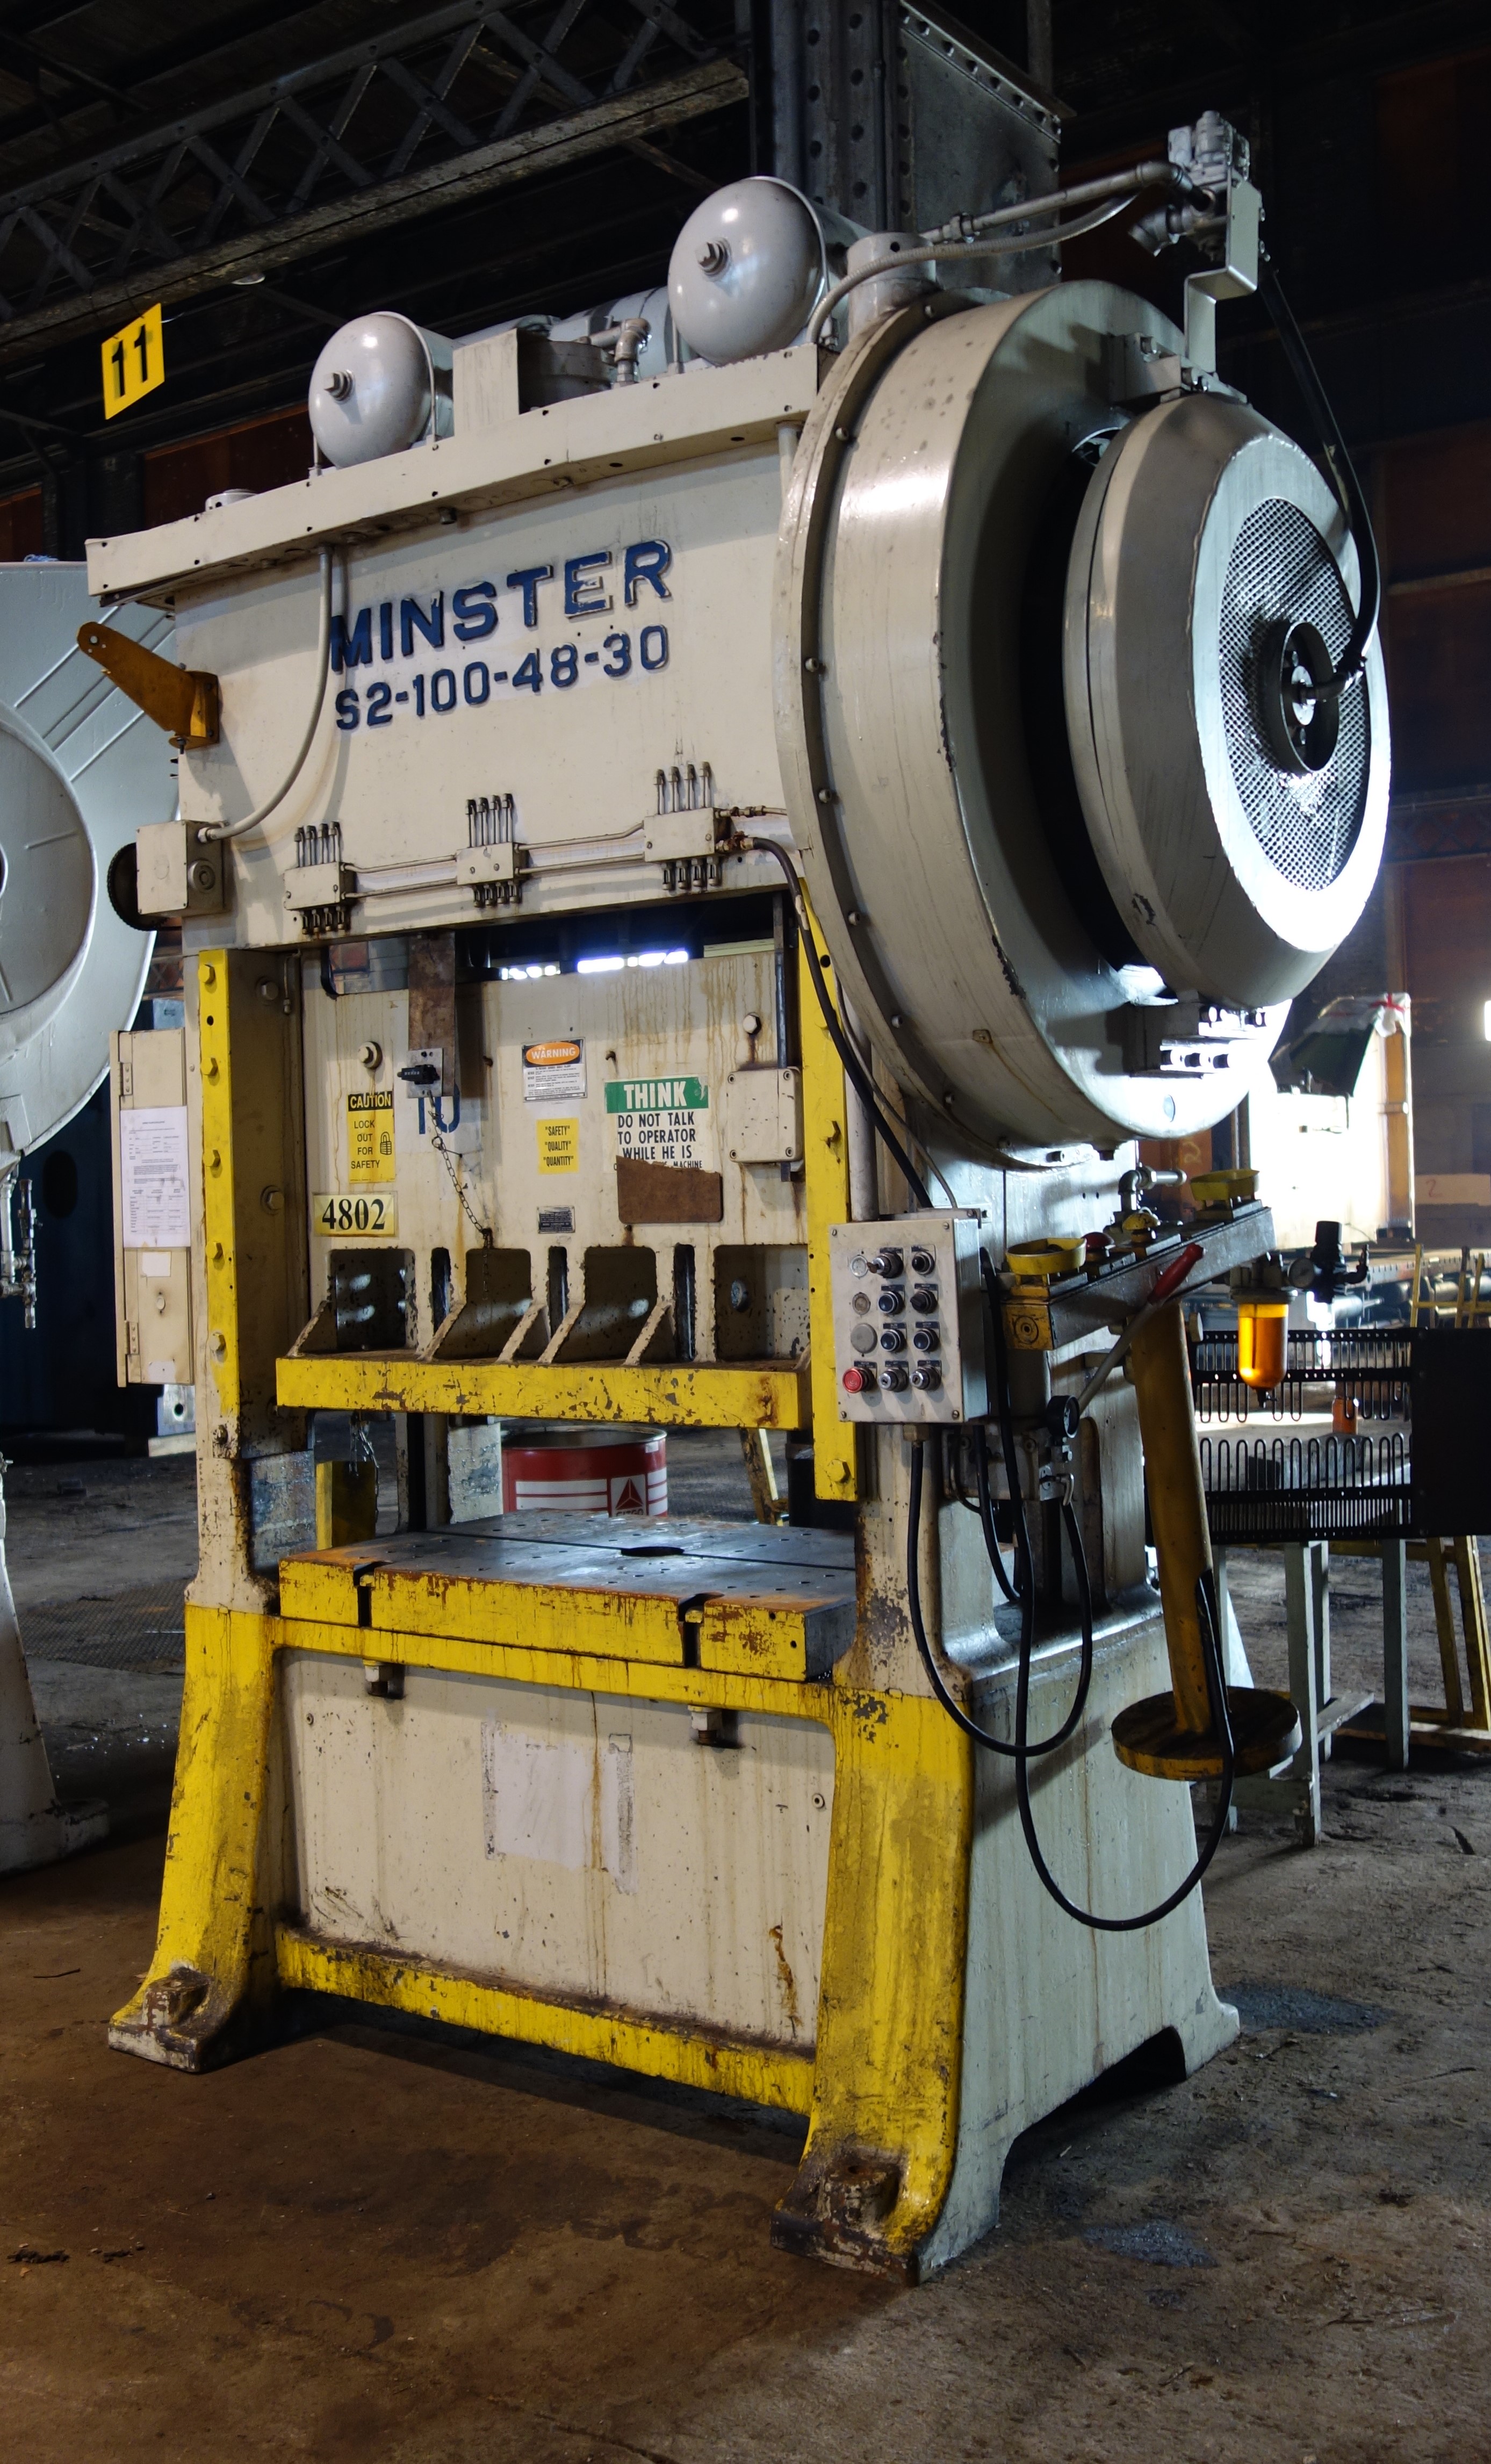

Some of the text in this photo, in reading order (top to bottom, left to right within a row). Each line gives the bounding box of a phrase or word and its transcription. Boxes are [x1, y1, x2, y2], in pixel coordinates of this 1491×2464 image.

[112, 324, 148, 398] 11
[330, 539, 671, 673] MINSTER
[335, 624, 669, 730] S2-100-48-30
[531, 1047, 576, 1060] WARNING
[350, 1094, 391, 1108] CAUTION
[624, 1081, 687, 1109] THINK
[354, 1120, 375, 1129] LOCK
[618, 1112, 694, 1128] DO NOT TALK
[357, 1133, 373, 1142] OUT
[618, 1128, 696, 1144] TO OPERATOR
[357, 1147, 373, 1155] FOR
[622, 1145, 692, 1161] WHILE HE IS
[351, 1159, 380, 1169] SAFETY
[673, 1161, 702, 1169] MACHINE
[322, 1199, 385, 1230] 4802
